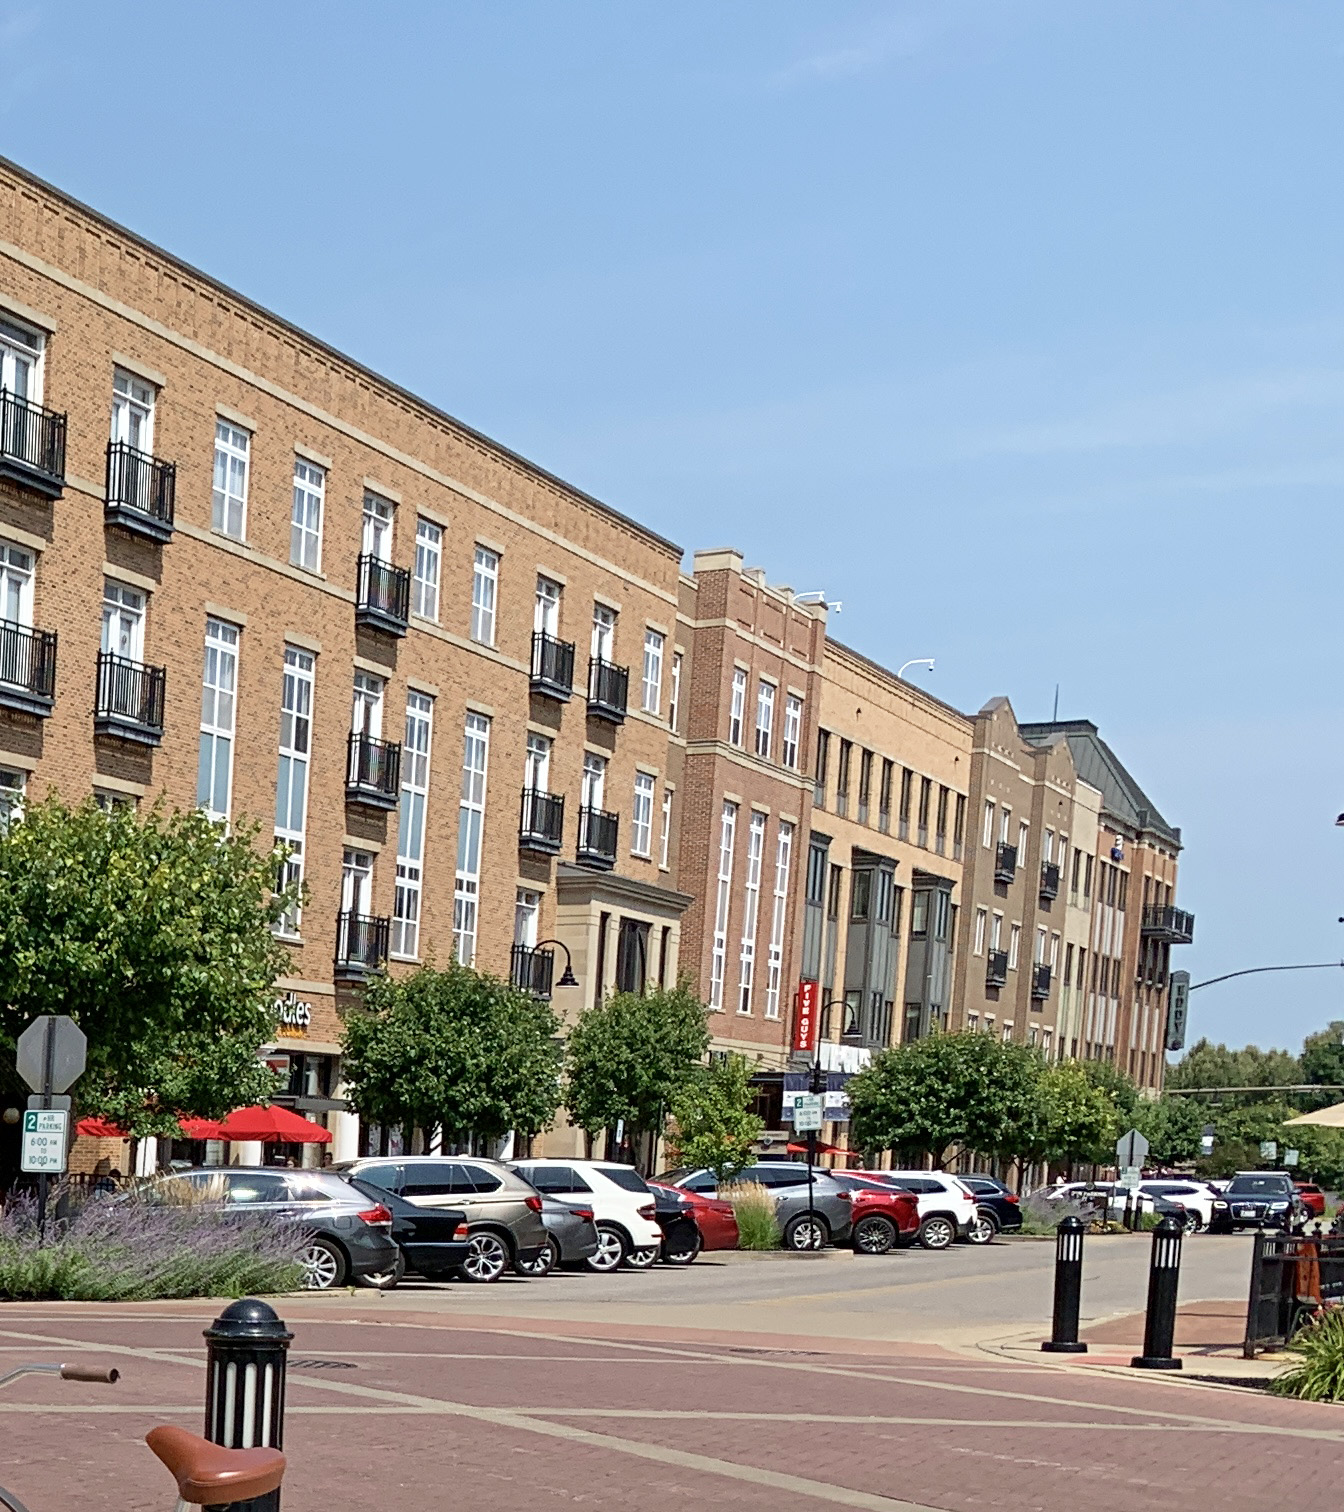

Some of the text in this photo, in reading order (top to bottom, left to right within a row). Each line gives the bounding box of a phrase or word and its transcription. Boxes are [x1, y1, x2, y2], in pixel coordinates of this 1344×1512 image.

[801, 984, 812, 1015] FIVE
[799, 1019, 810, 1048] GUYS
[27, 1115, 36, 1129] 2
[38, 1122, 62, 1131] PARKING
[30, 1137, 48, 1147] 6:00
[28, 1155, 48, 1165] 10:00
